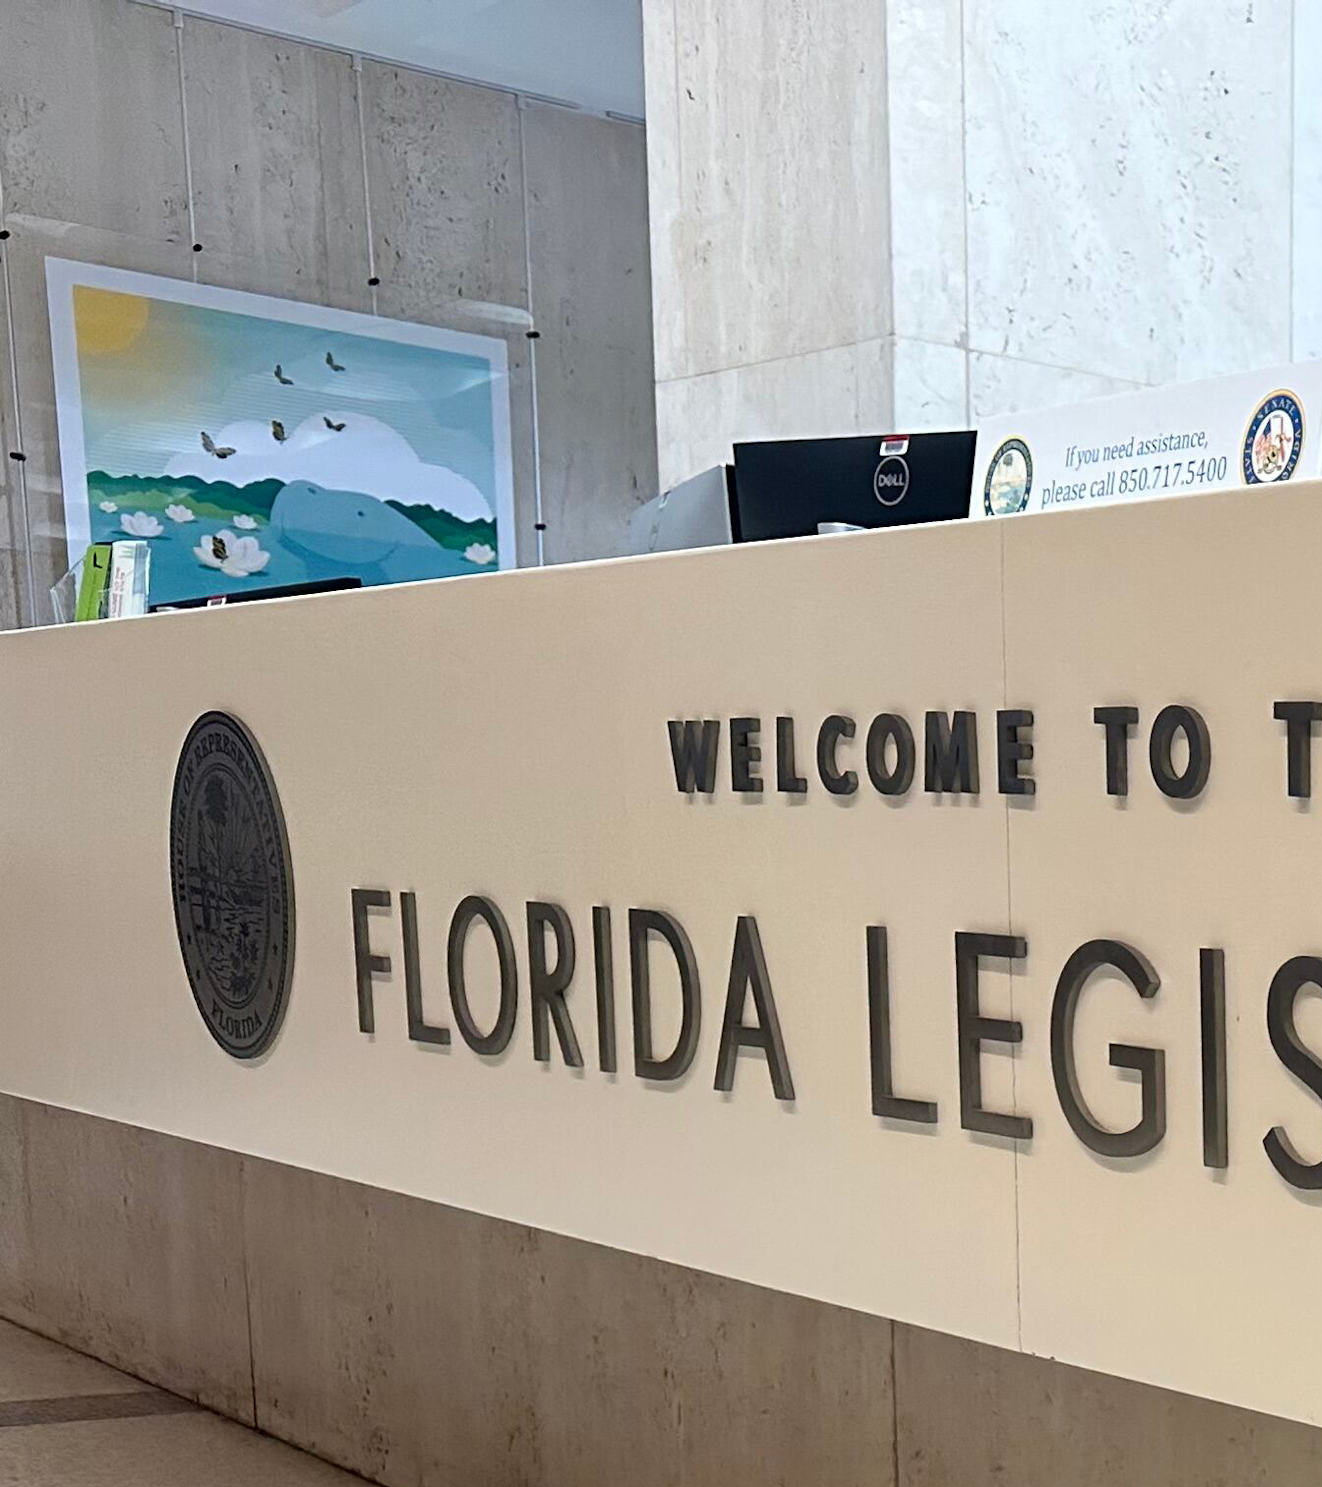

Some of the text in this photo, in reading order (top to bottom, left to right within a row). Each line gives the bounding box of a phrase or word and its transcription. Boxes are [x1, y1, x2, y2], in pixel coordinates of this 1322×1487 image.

[1065, 431, 1208, 471] If you need assistance,
[878, 473, 904, 487] DELL
[1041, 456, 1227, 509] please call 850.717.5400
[668, 709, 1034, 795] WELCOME
[1092, 705, 1212, 800] TO
[352, 887, 796, 1101] FLORIDA
[211, 998, 263, 1040] FLORIDA
